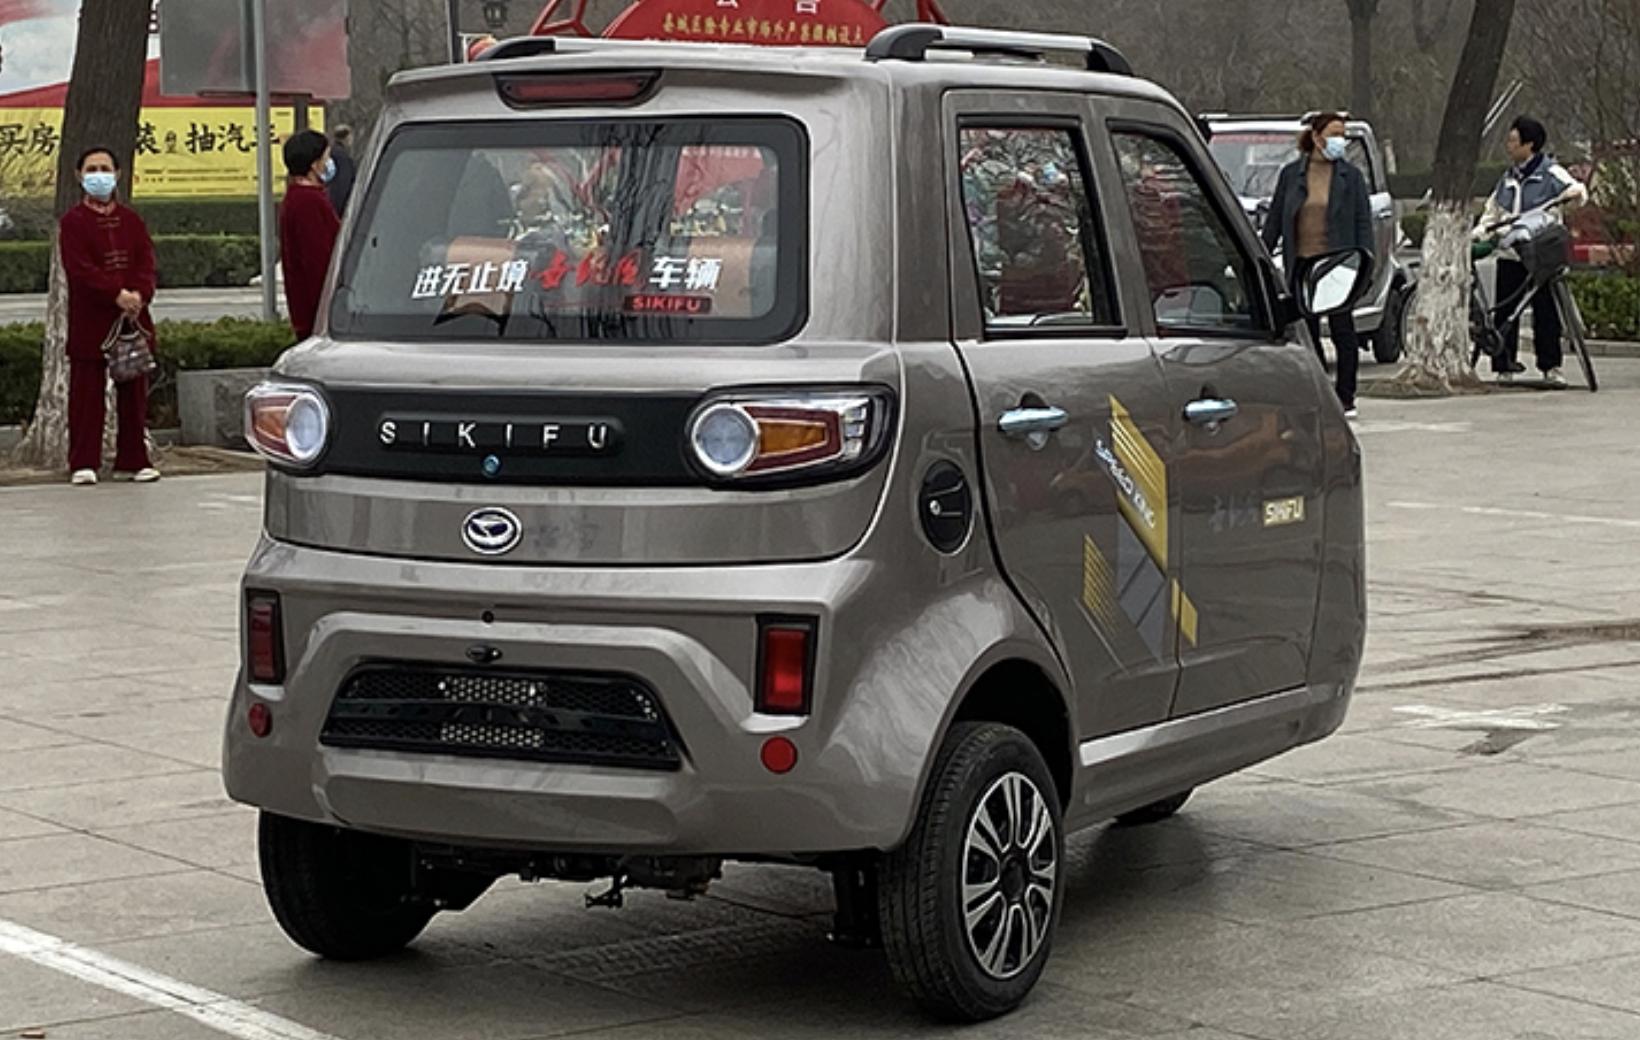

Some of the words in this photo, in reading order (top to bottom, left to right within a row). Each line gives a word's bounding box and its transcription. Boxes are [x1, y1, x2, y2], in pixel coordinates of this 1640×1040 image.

[649, 256, 723, 290] 车辆
[632, 295, 702, 312] SIKIFU
[380, 421, 608, 449] SIKIFU
